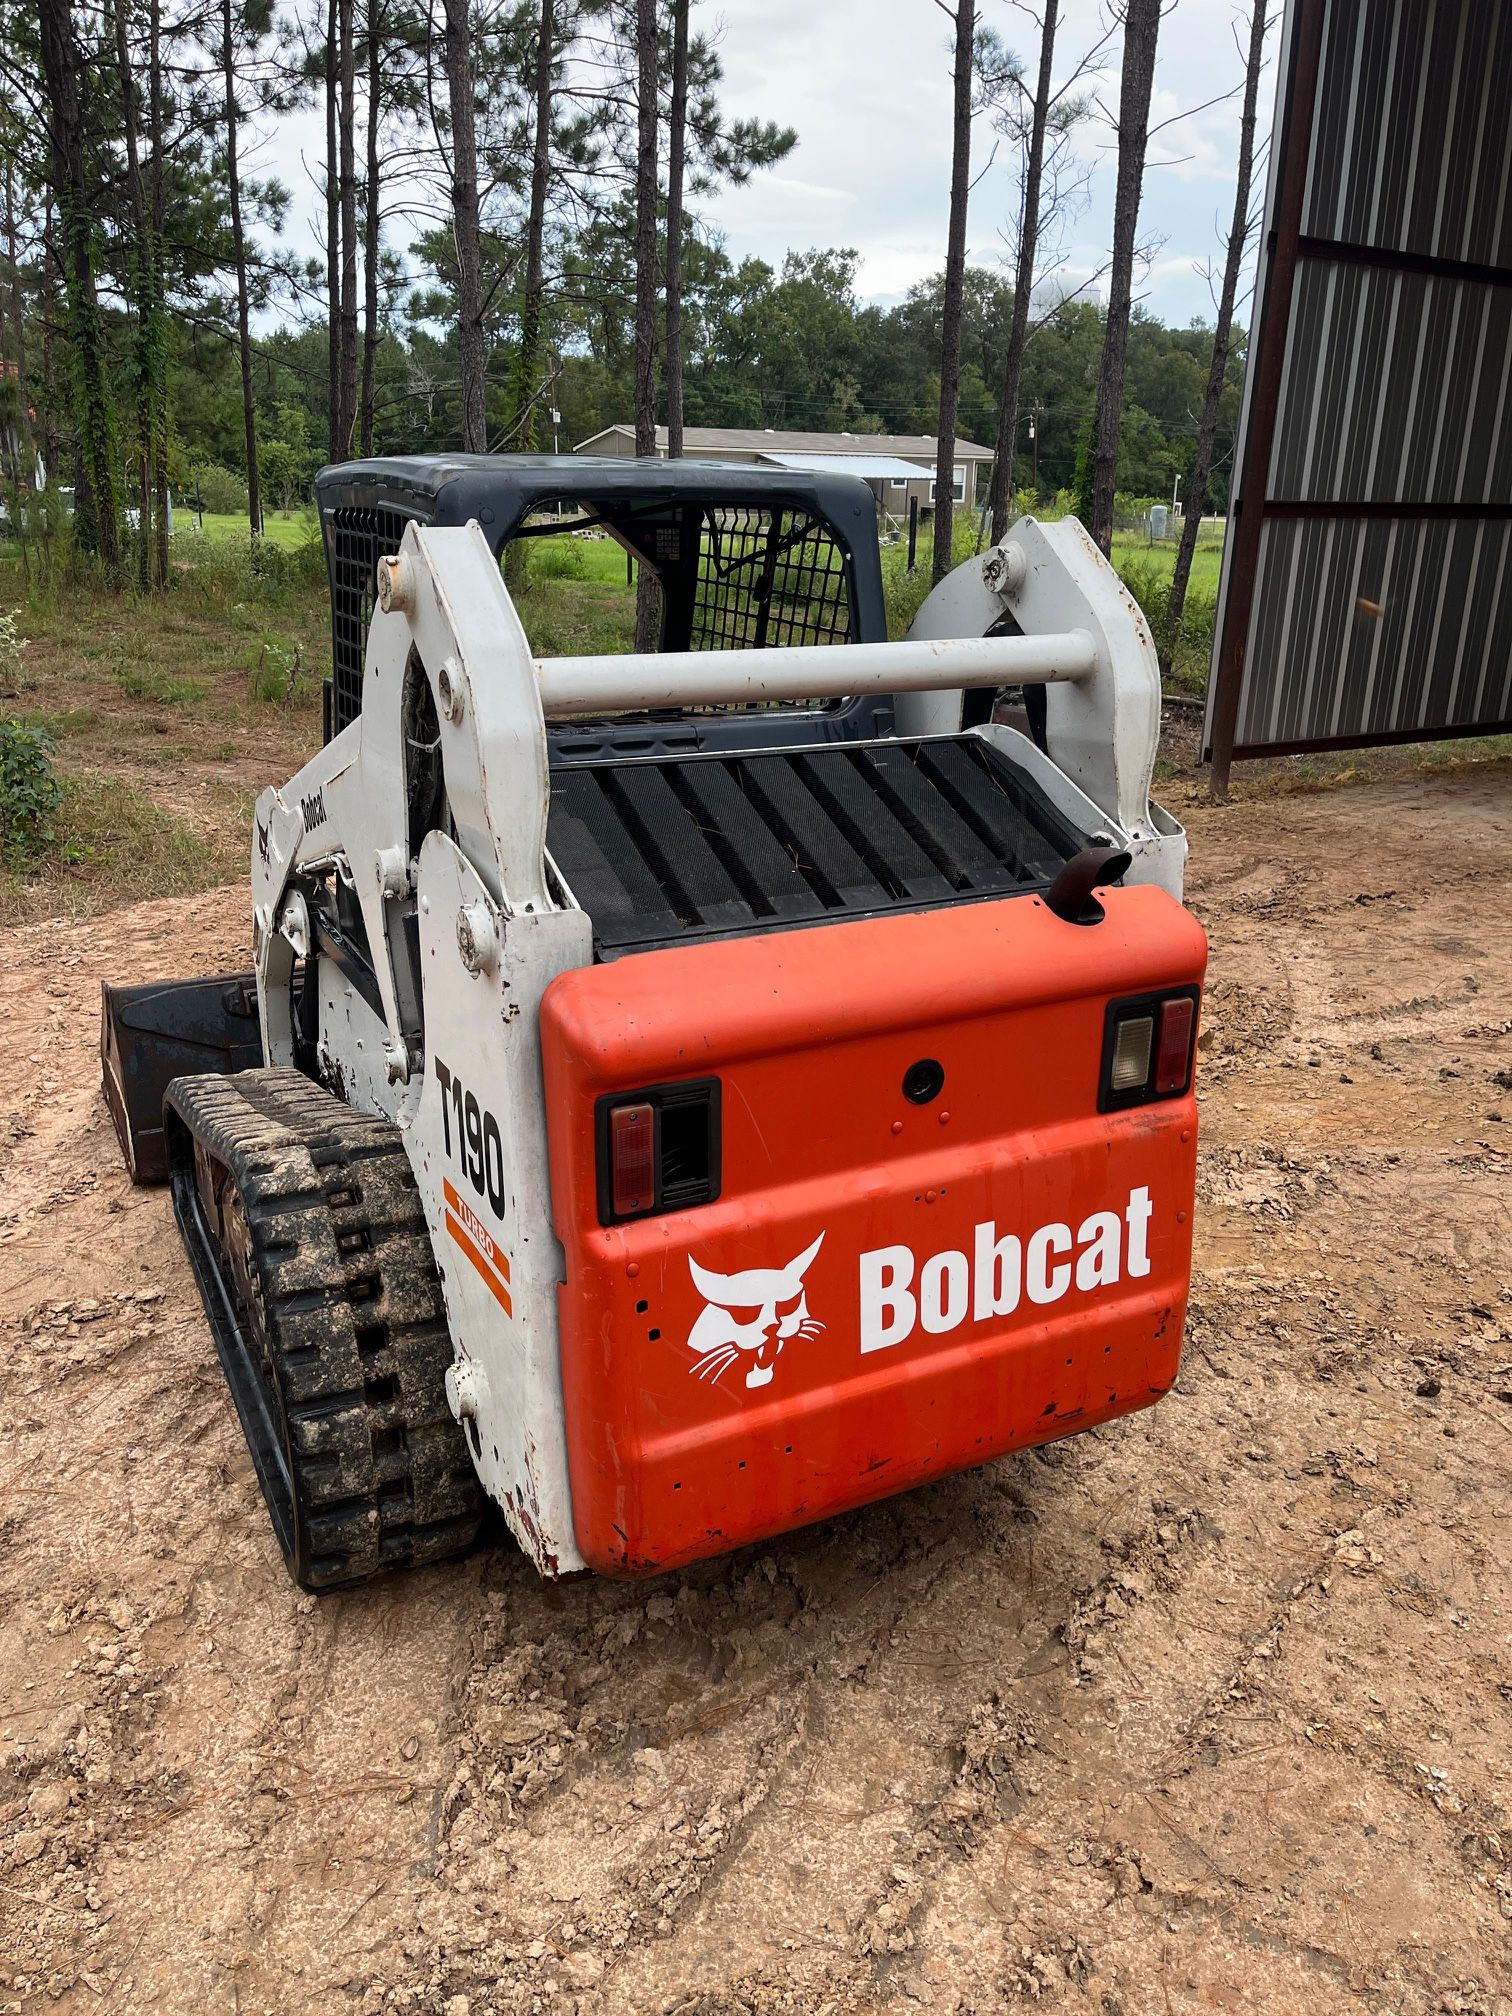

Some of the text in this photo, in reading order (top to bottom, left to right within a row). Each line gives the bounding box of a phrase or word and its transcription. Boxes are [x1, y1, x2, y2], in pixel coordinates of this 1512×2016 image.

[301, 786, 327, 833] Bobcat
[435, 1055, 505, 1221] T190
[456, 1195, 494, 1259] TURBO
[860, 1185, 1153, 1354] Bobcat
